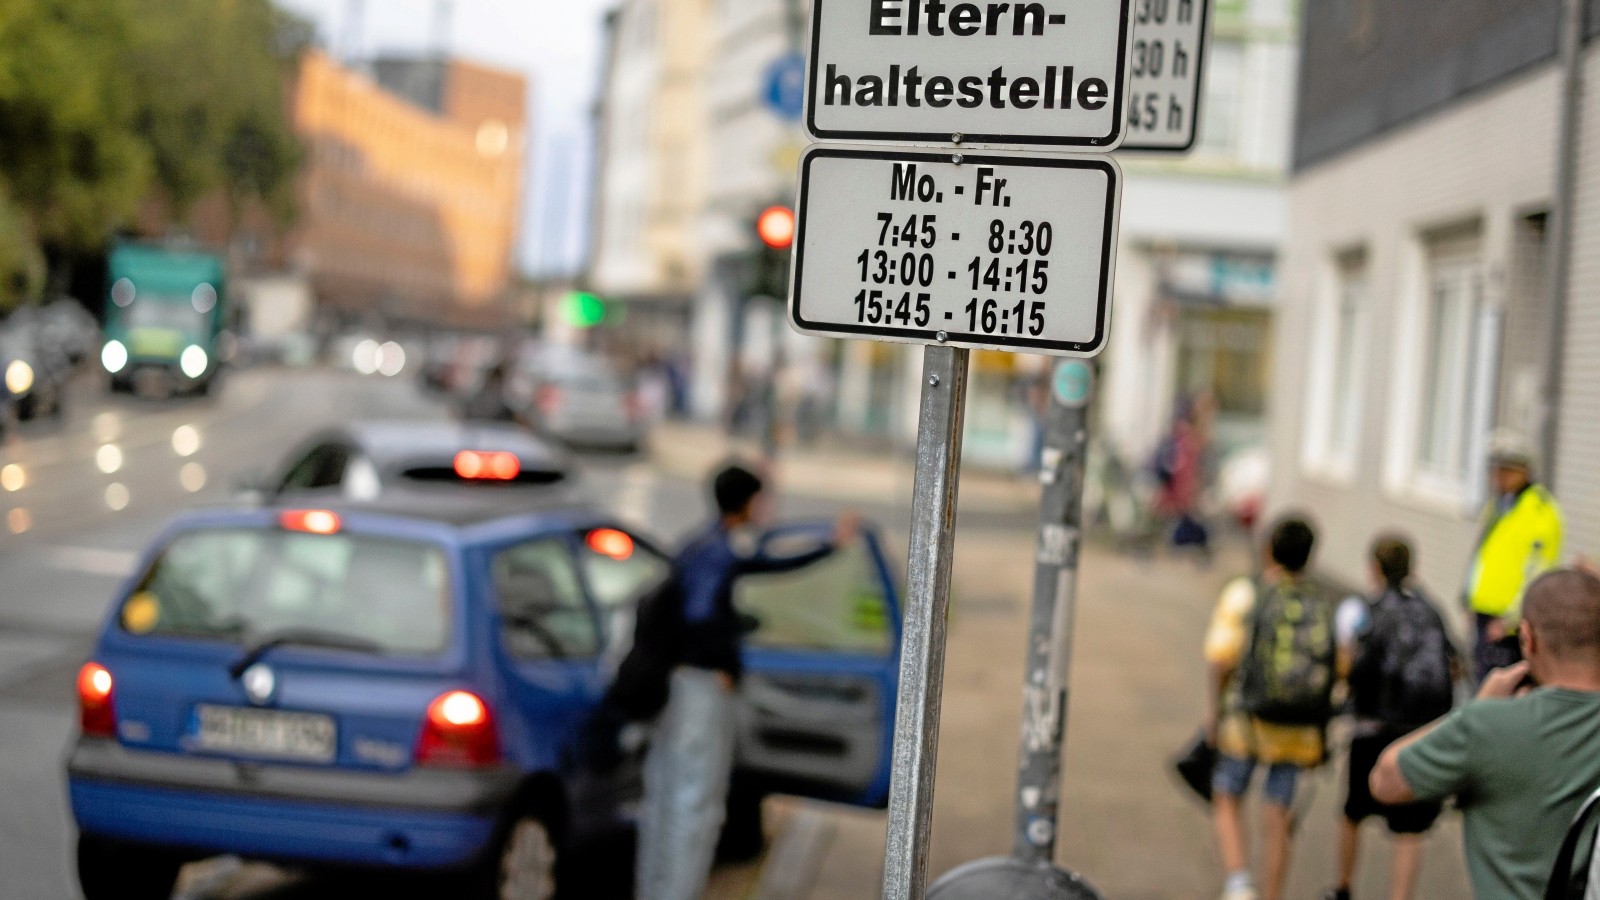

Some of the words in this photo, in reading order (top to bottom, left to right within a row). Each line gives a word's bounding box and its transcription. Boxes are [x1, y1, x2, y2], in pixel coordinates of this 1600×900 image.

[869, 0, 1066, 36] Eltern-
[1172, 39, 1188, 78] h
[825, 64, 1108, 110] haltestelle
[1167, 93, 1182, 131] h
[890, 163, 943, 202] Mo.
[974, 168, 1011, 206] Fr.
[877, 213, 936, 248] 7:45
[988, 219, 1053, 256] 8:30
[857, 249, 934, 286] 13:00
[967, 257, 1049, 294] 14:15
[854, 289, 931, 326] 15:45
[964, 298, 1046, 336] 16:15
